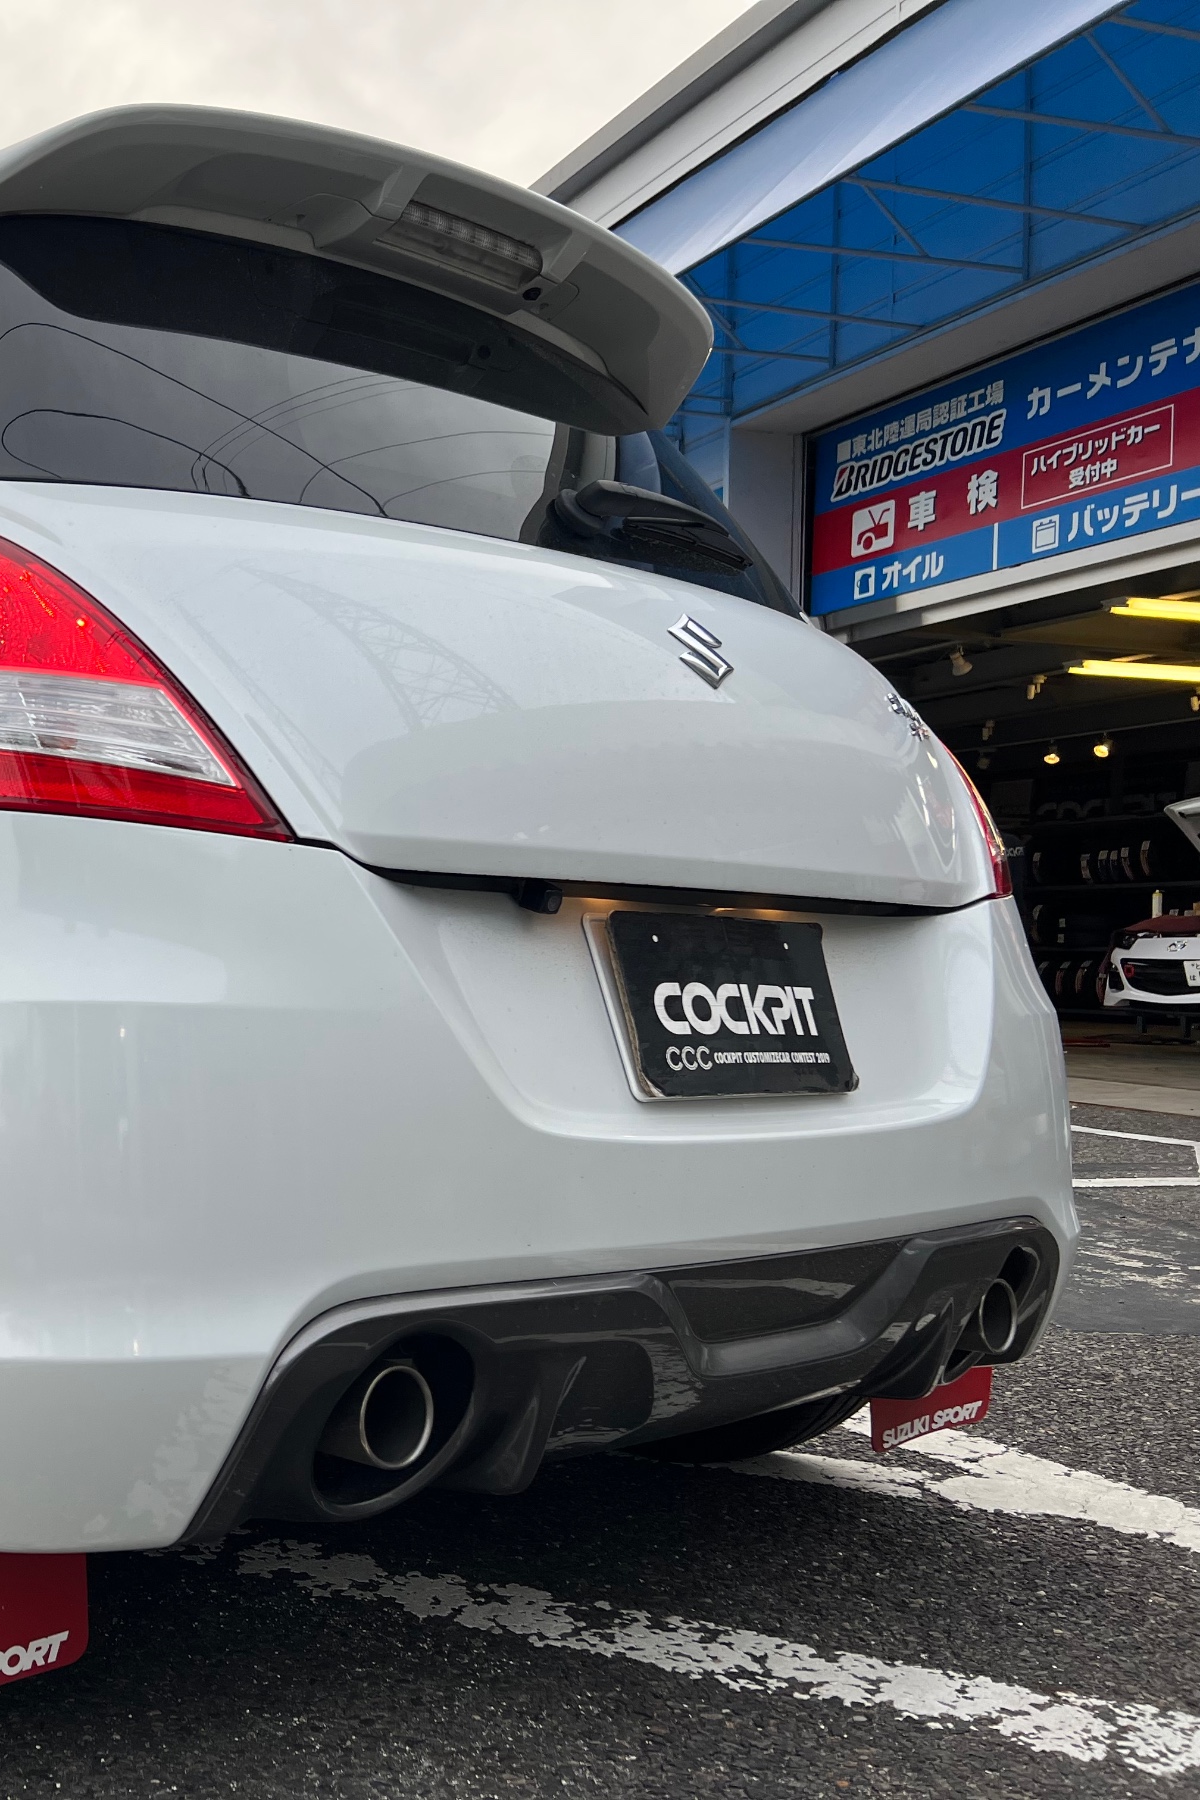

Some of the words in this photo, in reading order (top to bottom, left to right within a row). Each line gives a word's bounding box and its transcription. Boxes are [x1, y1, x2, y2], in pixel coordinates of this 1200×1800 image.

[832, 410, 1006, 501] BRIDGESTONE
[1031, 422, 1161, 476] ハイブリッドカー
[1068, 457, 1118, 489] 受付中
[881, 551, 945, 591] オイル
[653, 982, 819, 1036] COCKPIT
[665, 1046, 713, 1071] CCC
[714, 1052, 743, 1064] COCKPIT
[791, 1053, 816, 1064] CONTEST
[882, 1414, 930, 1449] SUZUKI
[931, 1400, 983, 1430] SPORT
